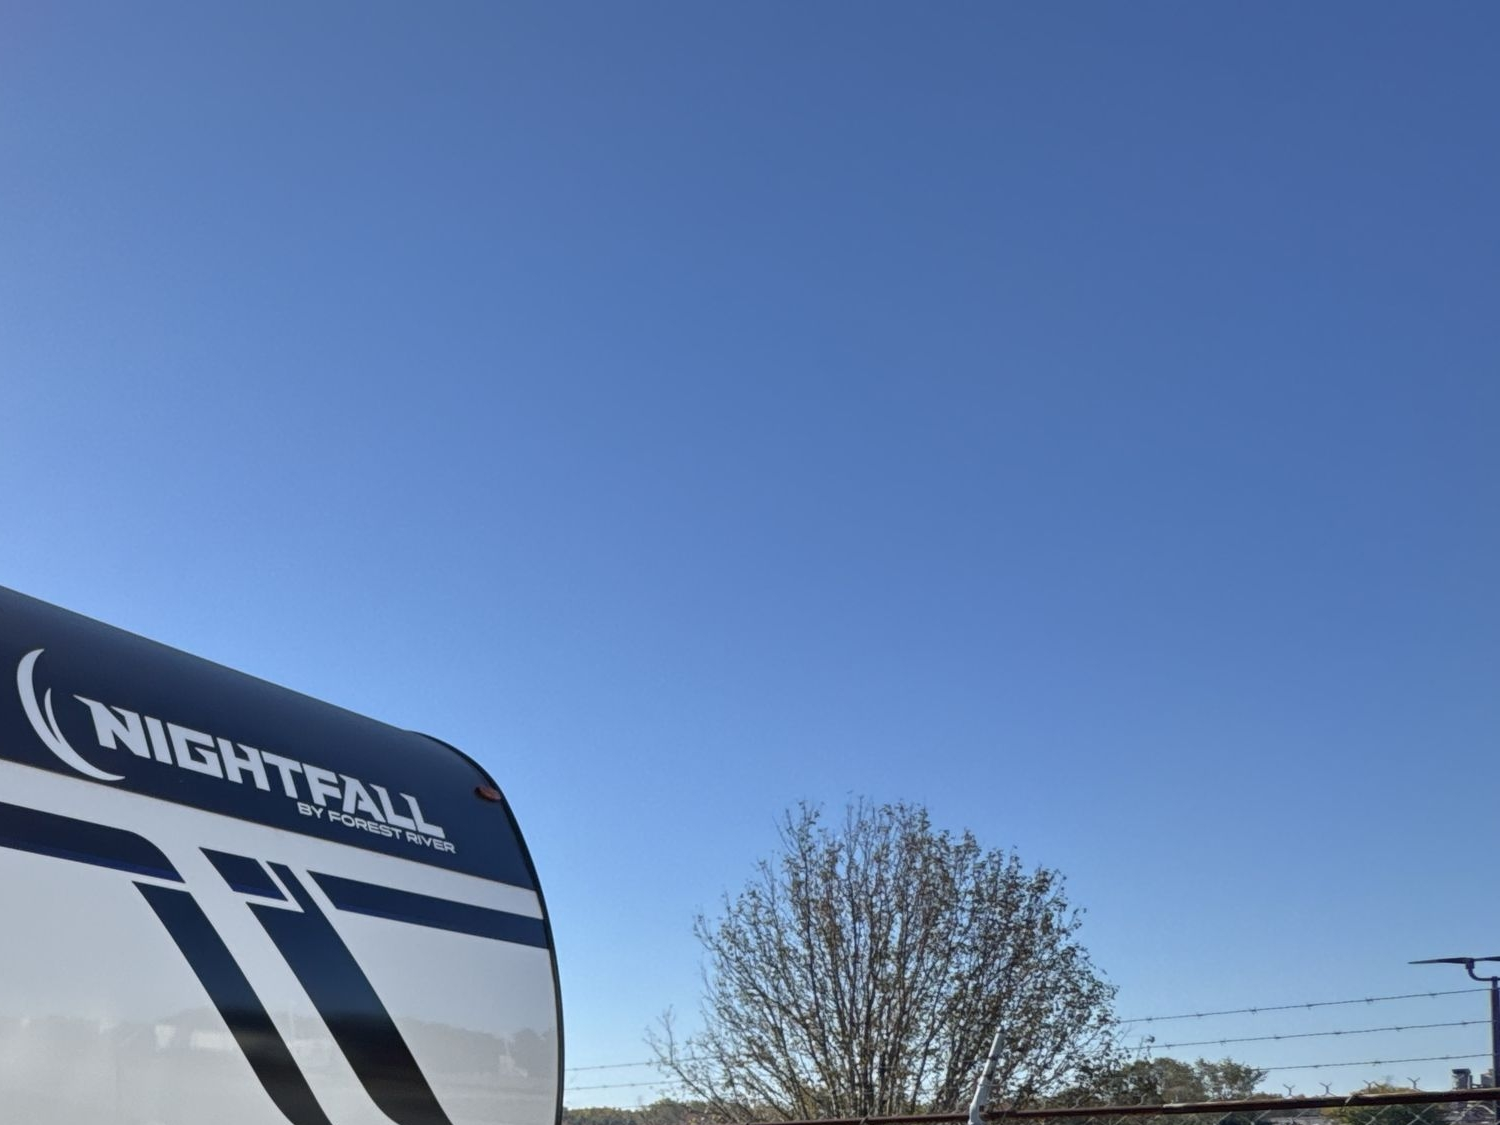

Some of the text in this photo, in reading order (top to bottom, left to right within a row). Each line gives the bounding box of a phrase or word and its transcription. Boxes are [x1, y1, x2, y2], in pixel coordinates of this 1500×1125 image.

[73, 694, 446, 839] NIGHTFALL
[297, 801, 457, 854] BY FOREST RIVER
